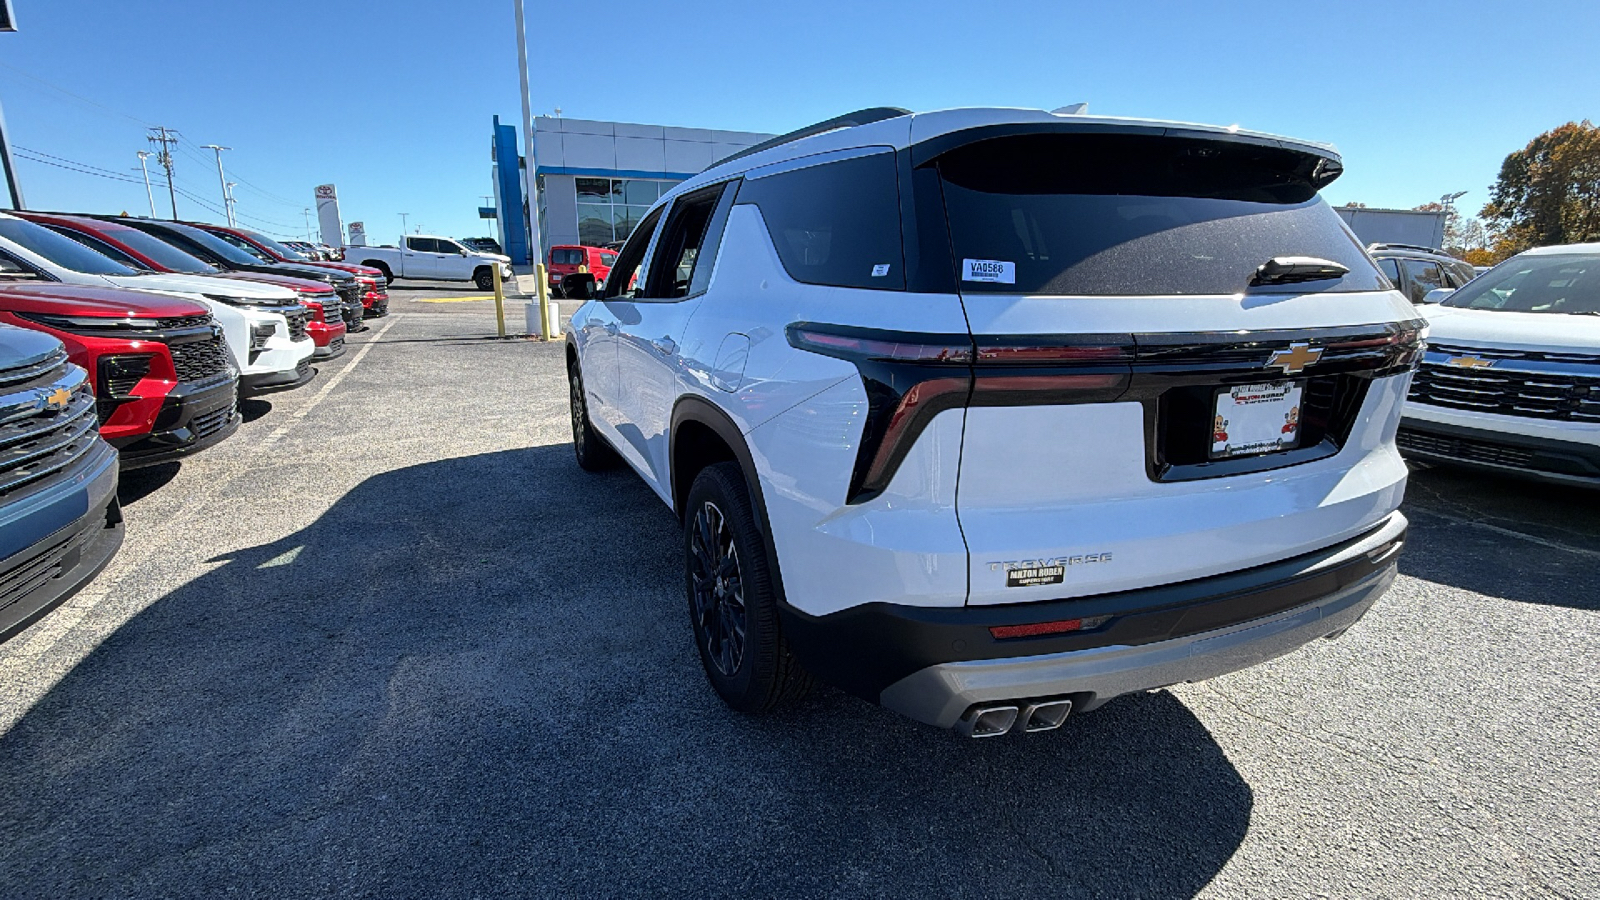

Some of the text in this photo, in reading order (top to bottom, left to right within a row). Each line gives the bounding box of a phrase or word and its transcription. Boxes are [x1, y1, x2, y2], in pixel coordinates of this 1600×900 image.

[986, 552, 1112, 571] TRAVERSE
[1010, 566, 1063, 579] MILTON RUBEN
